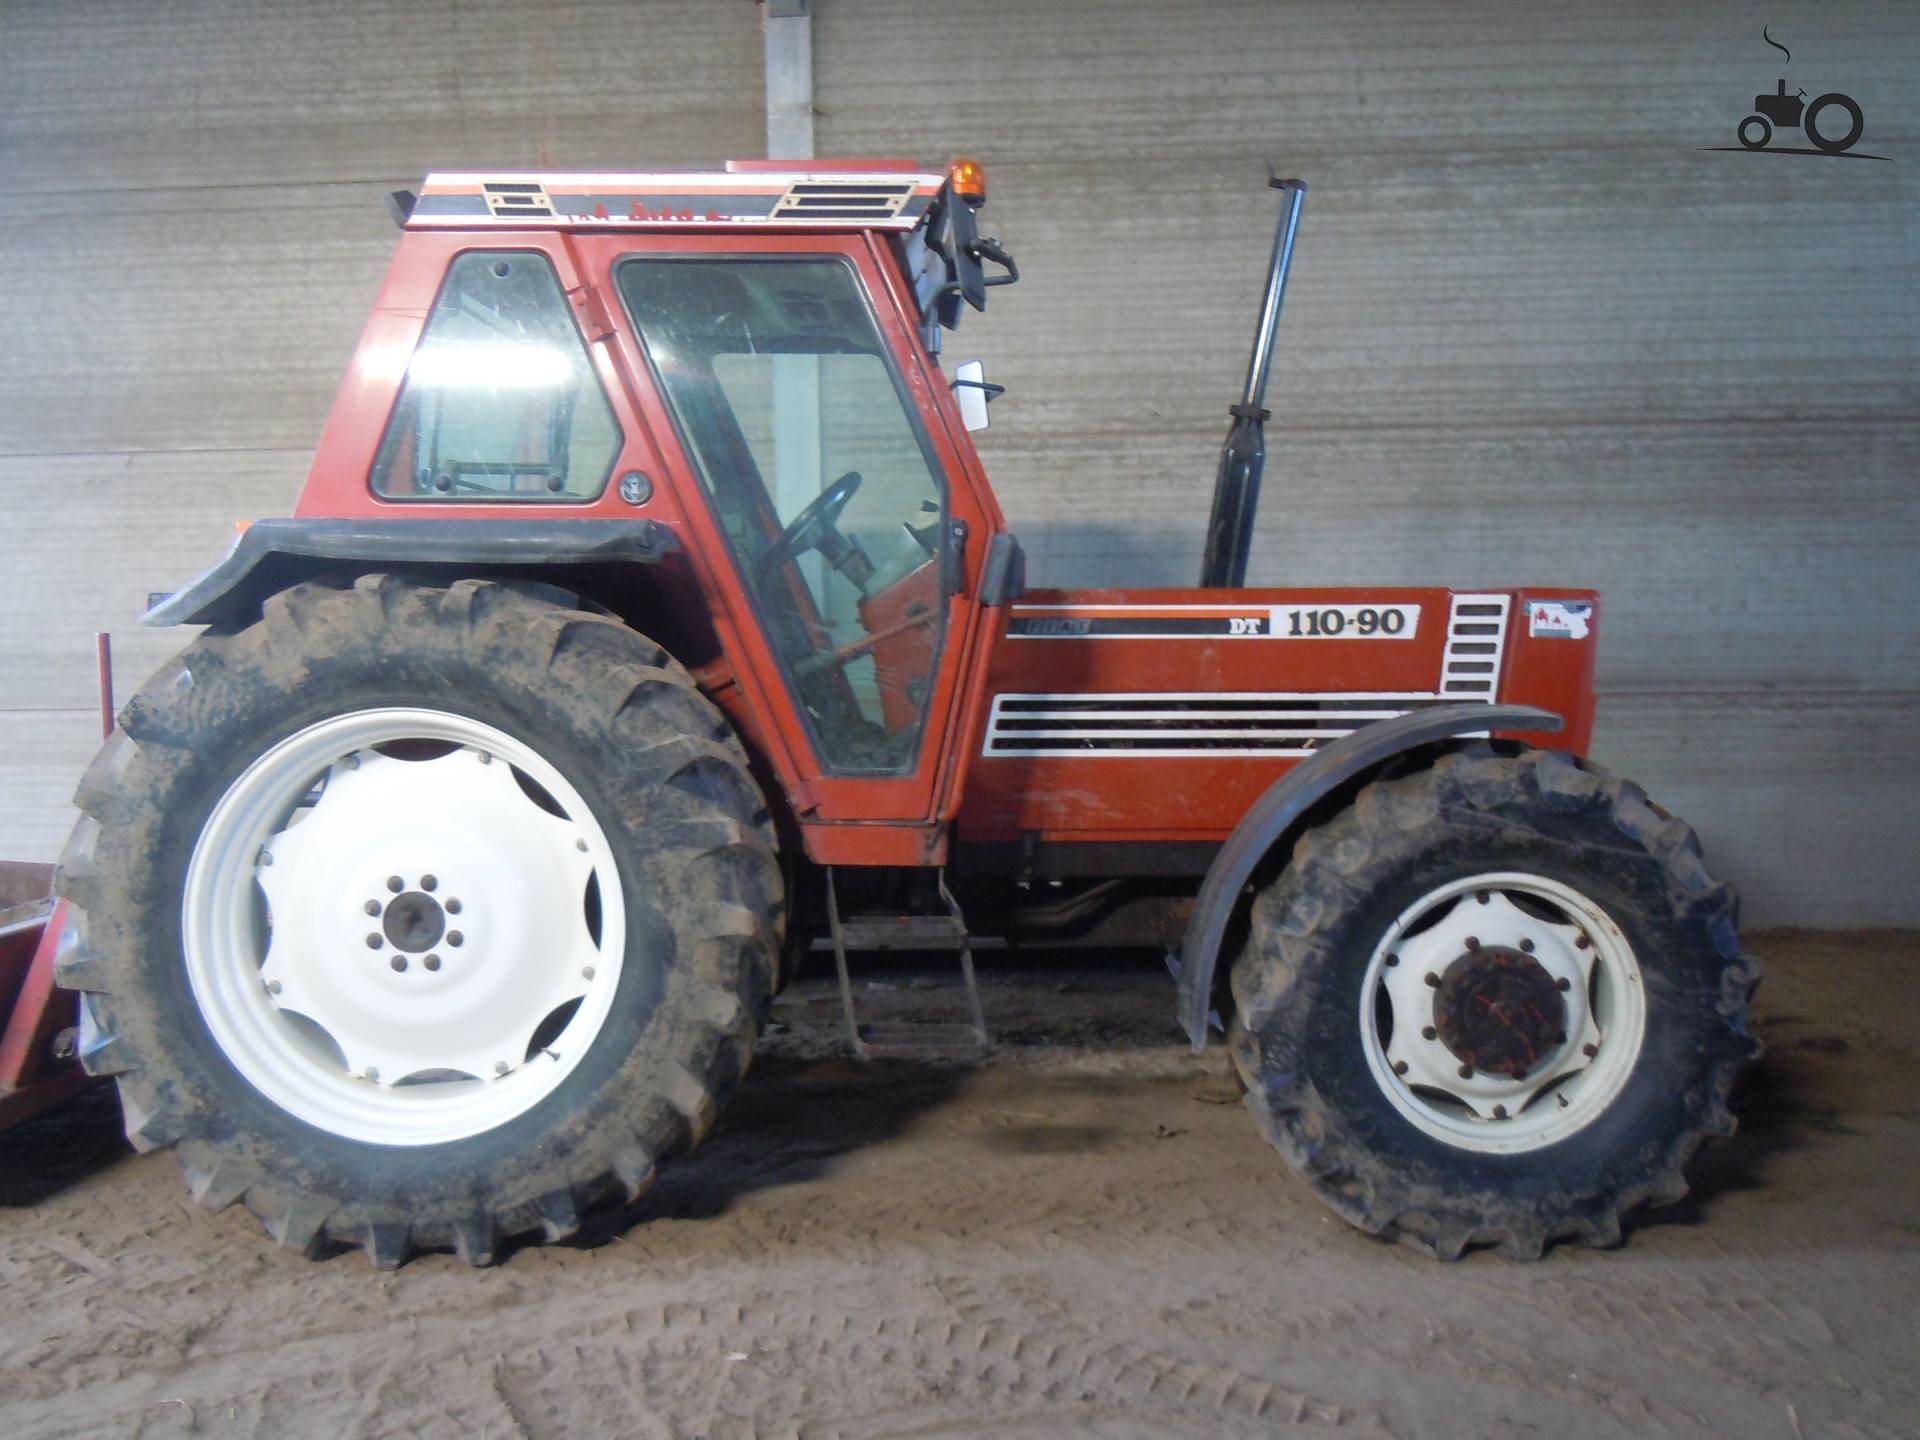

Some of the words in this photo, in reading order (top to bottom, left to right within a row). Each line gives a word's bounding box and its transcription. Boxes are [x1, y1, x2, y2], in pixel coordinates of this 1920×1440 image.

[1025, 618, 1091, 634] FIAT
[1229, 618, 1261, 634] DT
[1288, 608, 1405, 636] 110-90
